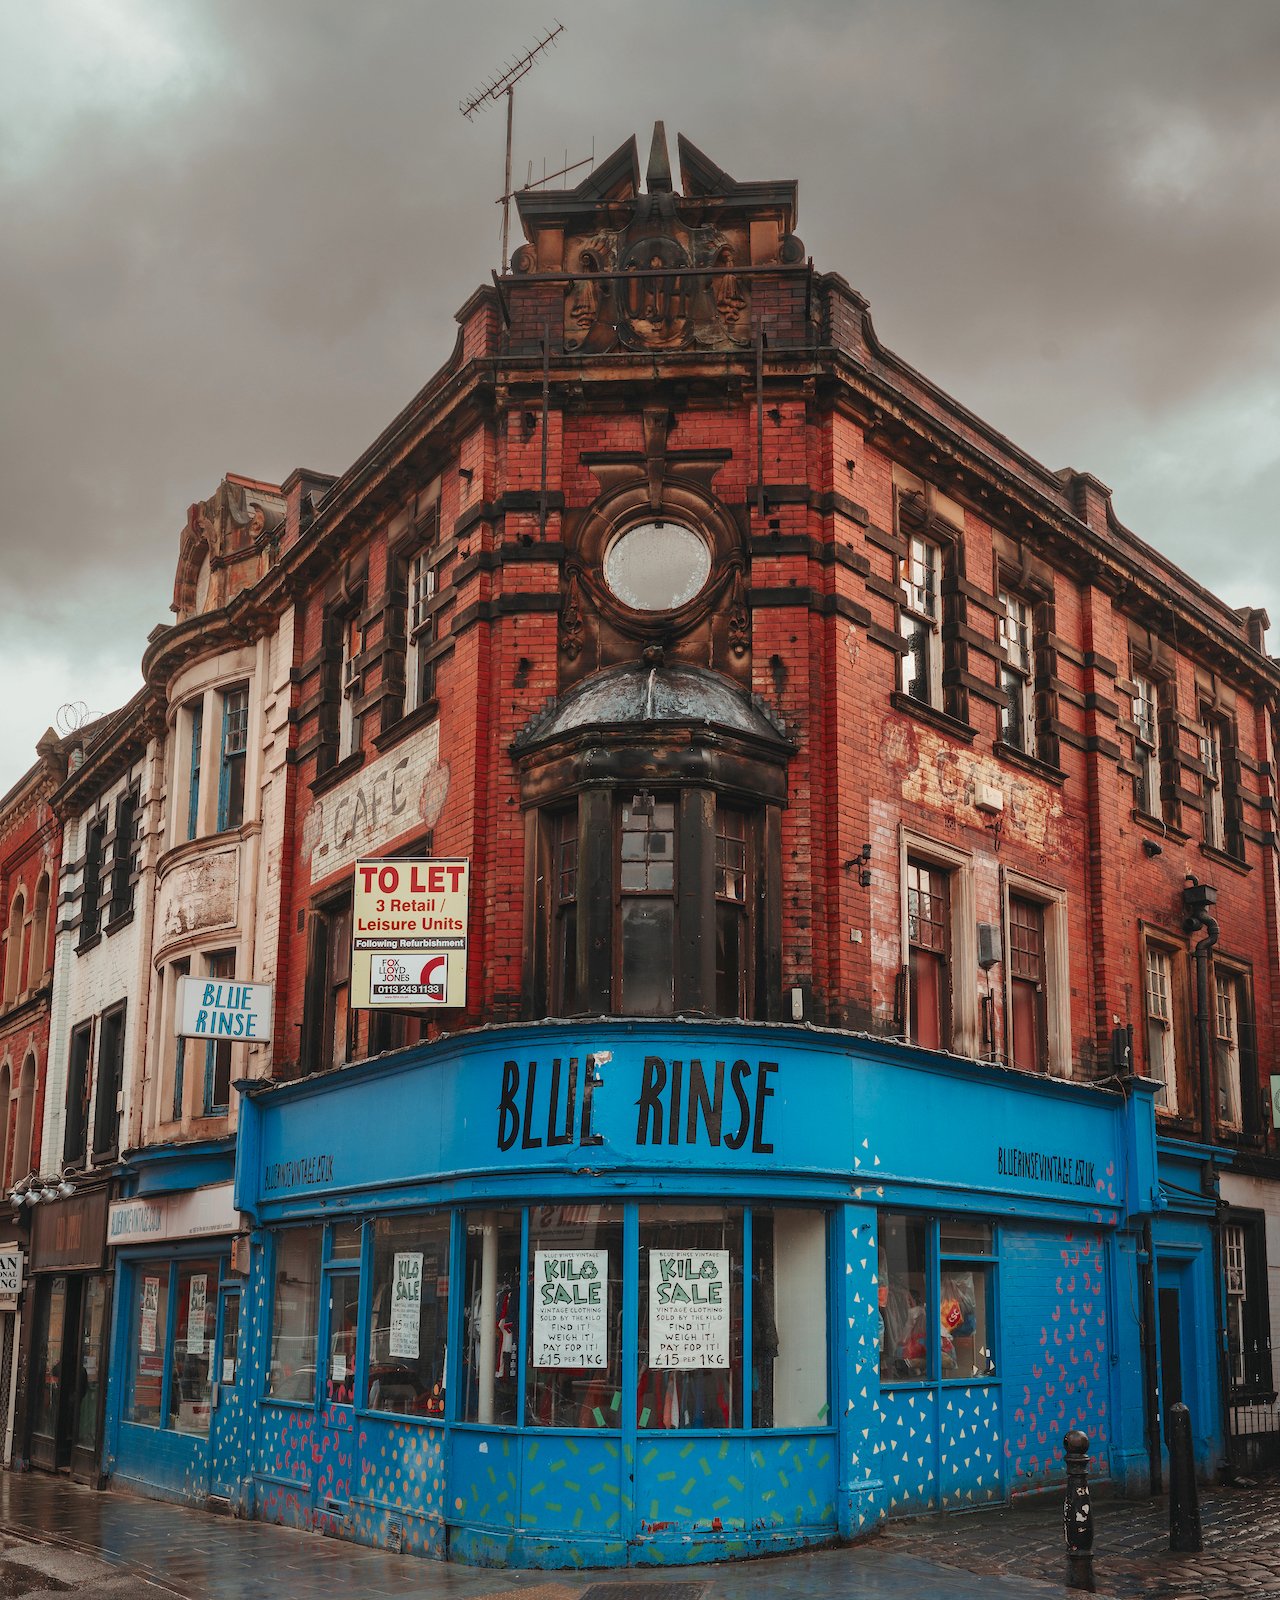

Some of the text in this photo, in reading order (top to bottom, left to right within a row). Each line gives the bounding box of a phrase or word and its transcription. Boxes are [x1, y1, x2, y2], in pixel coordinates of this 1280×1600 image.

[334, 756, 410, 850] CAFE
[359, 866, 465, 894] TO LET
[376, 899, 385, 912] 3
[390, 899, 435, 912] Retail
[358, 917, 463, 931] Leisure Units
[356, 939, 464, 949] Following Refurbishment
[382, 959, 400, 967] FOX
[379, 966, 406, 975] LLOYD
[382, 974, 410, 983] JONES
[378, 985, 399, 994] 0113
[202, 983, 254, 1011] BLUE
[195, 1009, 258, 1038] RINSE
[497, 1054, 779, 1154] BLUE RINSE
[544, 1259, 599, 1282] KILO
[659, 1258, 719, 1282] KILO
[396, 1281, 420, 1301] SALE
[540, 1281, 602, 1306] SALE
[656, 1281, 722, 1305] SALE
[551, 1323, 590, 1331] FIND IT!
[669, 1323, 692, 1331] FIND
[548, 1333, 594, 1342] WEIGH IT!
[665, 1333, 715, 1341] WEIGH IT!
[543, 1343, 598, 1352] PAY FOR IT!
[660, 1343, 720, 1352] PAY FOR IT!
[539, 1353, 561, 1366] £15
[579, 1354, 603, 1366] 1KG
[655, 1353, 680, 1366] £15
[700, 1353, 725, 1366] 1KG
